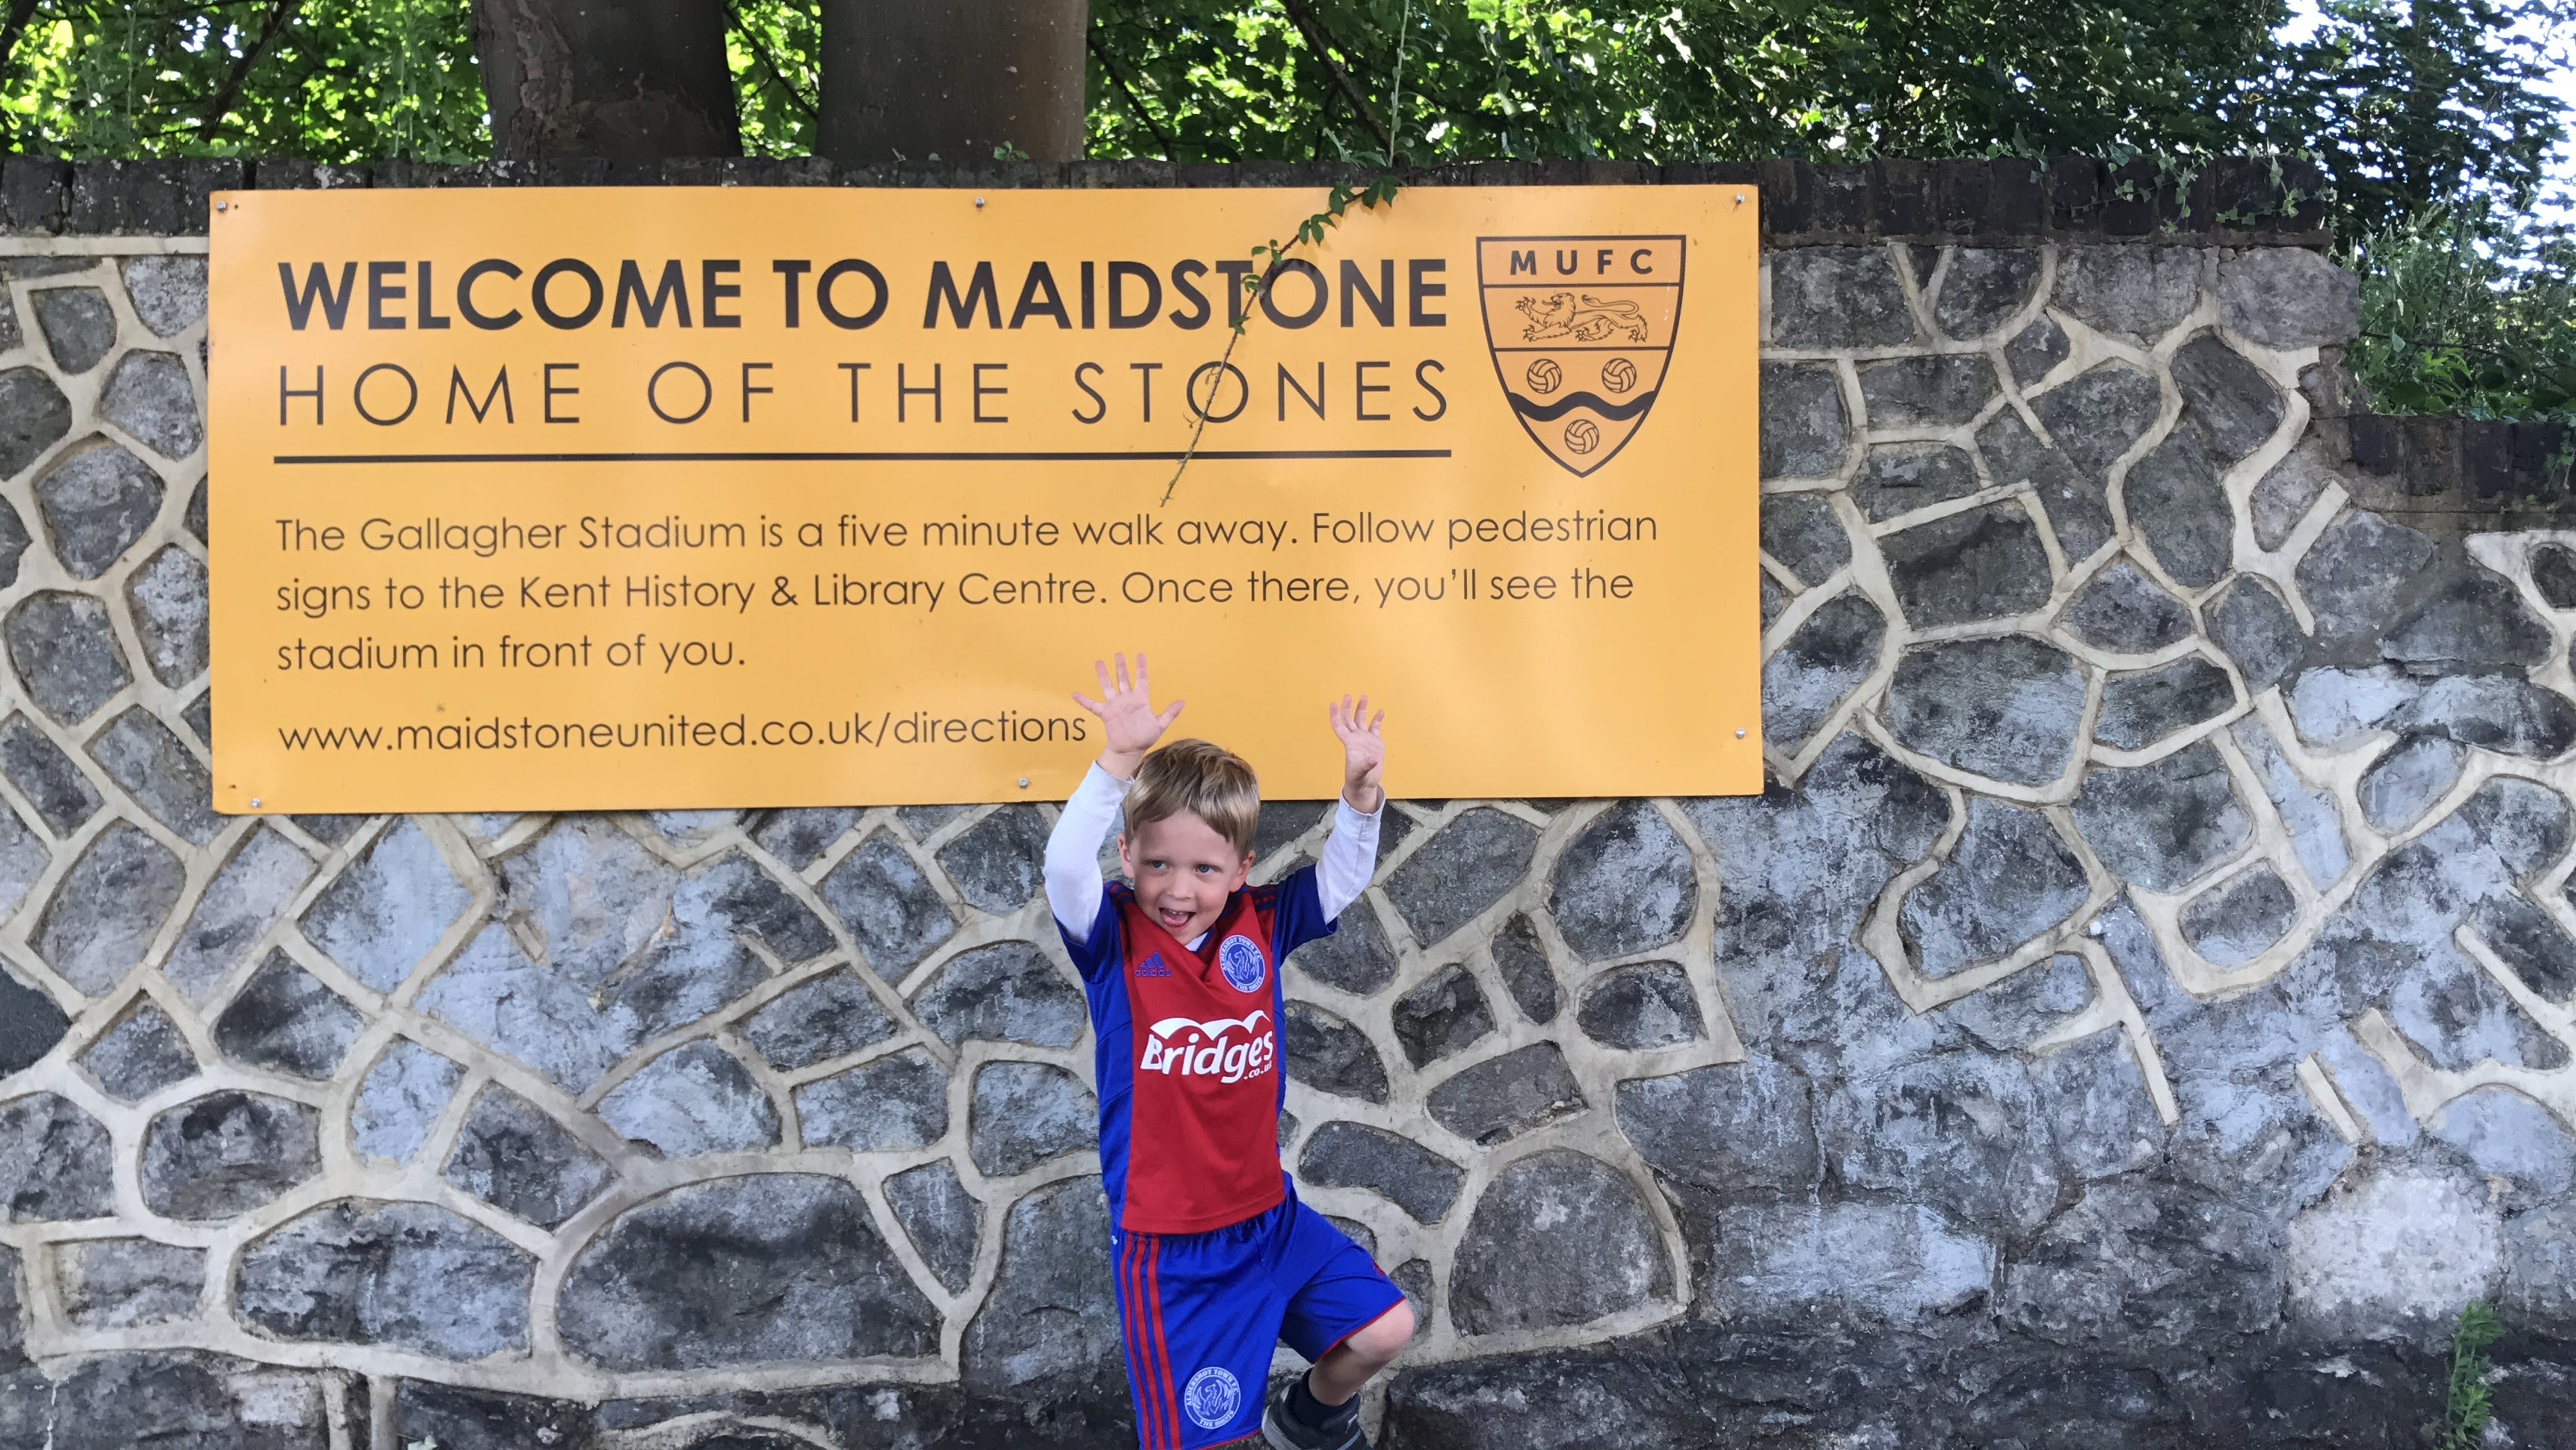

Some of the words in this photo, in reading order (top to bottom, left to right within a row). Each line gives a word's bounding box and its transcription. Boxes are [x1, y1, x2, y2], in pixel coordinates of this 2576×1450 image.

[1510, 248, 1653, 276] MUFC
[278, 258, 741, 331] WELCOME
[772, 258, 889, 330] TO
[923, 258, 1447, 331] MAIDSTONE
[280, 362, 580, 427] HOME
[648, 361, 773, 424] OF
[837, 362, 1009, 423] THE
[1071, 359, 1447, 424] STONES
[276, 519, 345, 551] The
[361, 518, 566, 557] Gallagher
[579, 516, 744, 548] Stadium
[760, 515, 783, 547] is
[798, 523, 822, 547] a
[838, 514, 907, 547] five
[923, 514, 1059, 546] minute
[1073, 514, 1163, 545] walk
[1177, 520, 1297, 551] away.
[1314, 511, 1434, 544] Follow
[1449, 509, 1656, 550] pedestrian
[277, 578, 370, 619] signs
[386, 578, 424, 609] to
[440, 577, 504, 609] the
[521, 576, 610, 608] Kent
[627, 575, 755, 614] History
[771, 575, 798, 606] &
[815, 573, 944, 612] Library
[959, 572, 1107, 605] Centre.
[1122, 572, 1233, 603] Once
[1247, 570, 1359, 603] there,
[1375, 569, 1476, 608] you'll
[1490, 576, 1557, 600] see
[1571, 567, 1633, 599] the
[279, 637, 437, 671] stadium
[453, 636, 484, 668] in
[500, 635, 592, 668] front
[607, 634, 645, 666] of
[660, 642, 744, 674] you.
[279, 710, 1086, 750] www.maidstoneunited.co.uk/directions
[1140, 1030, 1274, 1084] Bridges
